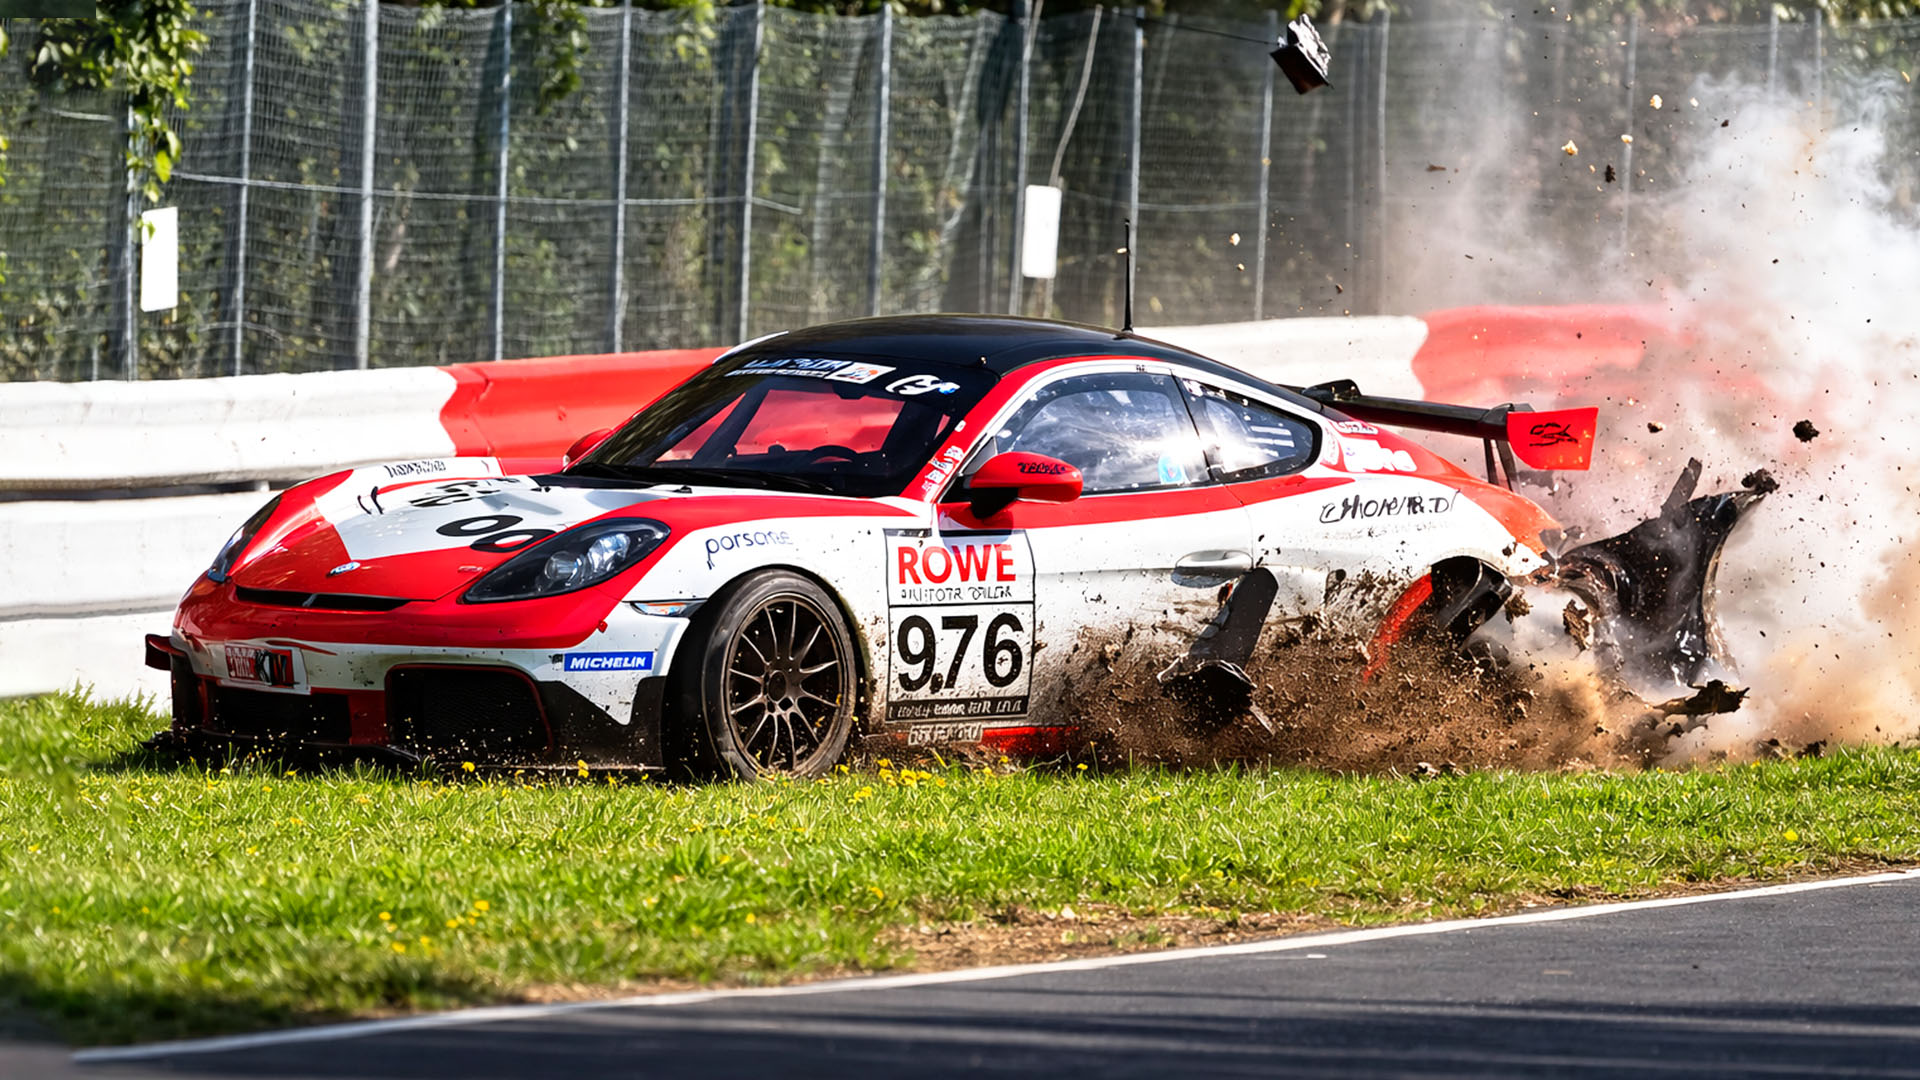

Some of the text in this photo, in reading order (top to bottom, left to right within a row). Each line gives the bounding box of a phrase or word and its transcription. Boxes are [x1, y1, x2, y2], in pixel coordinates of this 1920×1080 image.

[897, 544, 1016, 584] ROWE
[569, 656, 646, 669] MICHELIN
[897, 612, 1024, 693] 976
